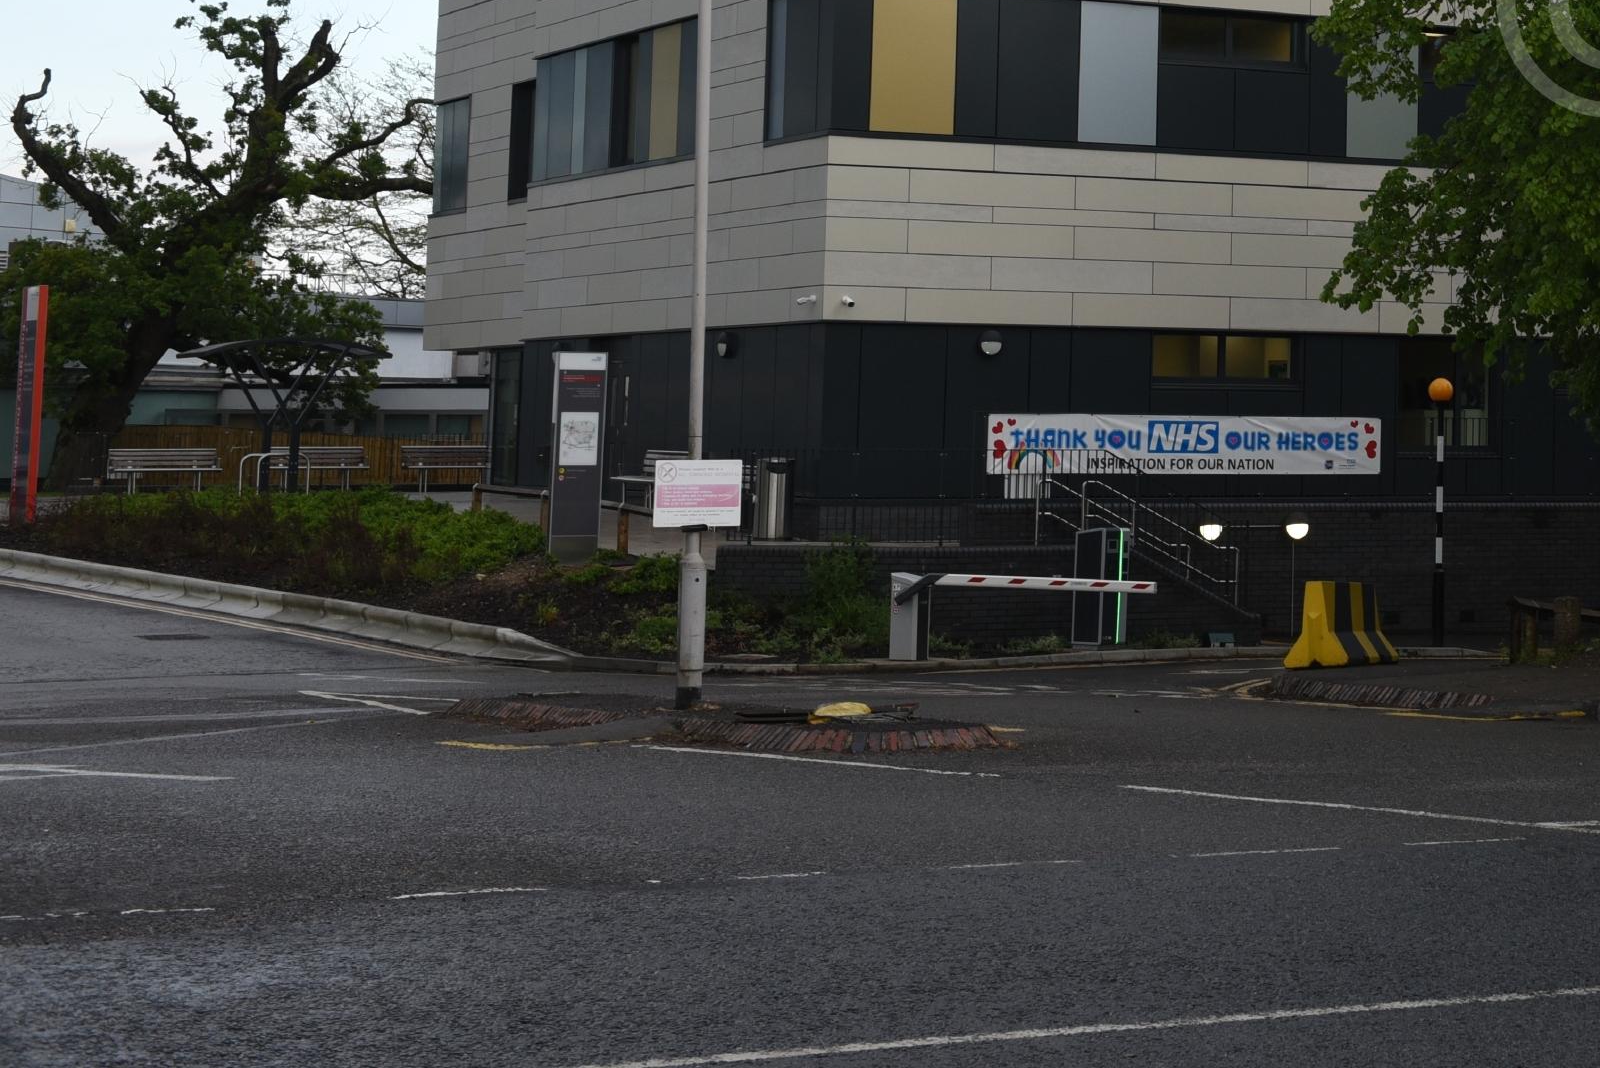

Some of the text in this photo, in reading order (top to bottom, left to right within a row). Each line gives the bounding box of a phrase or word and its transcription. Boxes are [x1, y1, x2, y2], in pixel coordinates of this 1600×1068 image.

[1149, 422, 1218, 452] NHS
[1225, 430, 1271, 452] OUR
[1276, 430, 1359, 452] HEROES
[1087, 457, 1274, 471] INSPIRATION FOR OUR NATION
